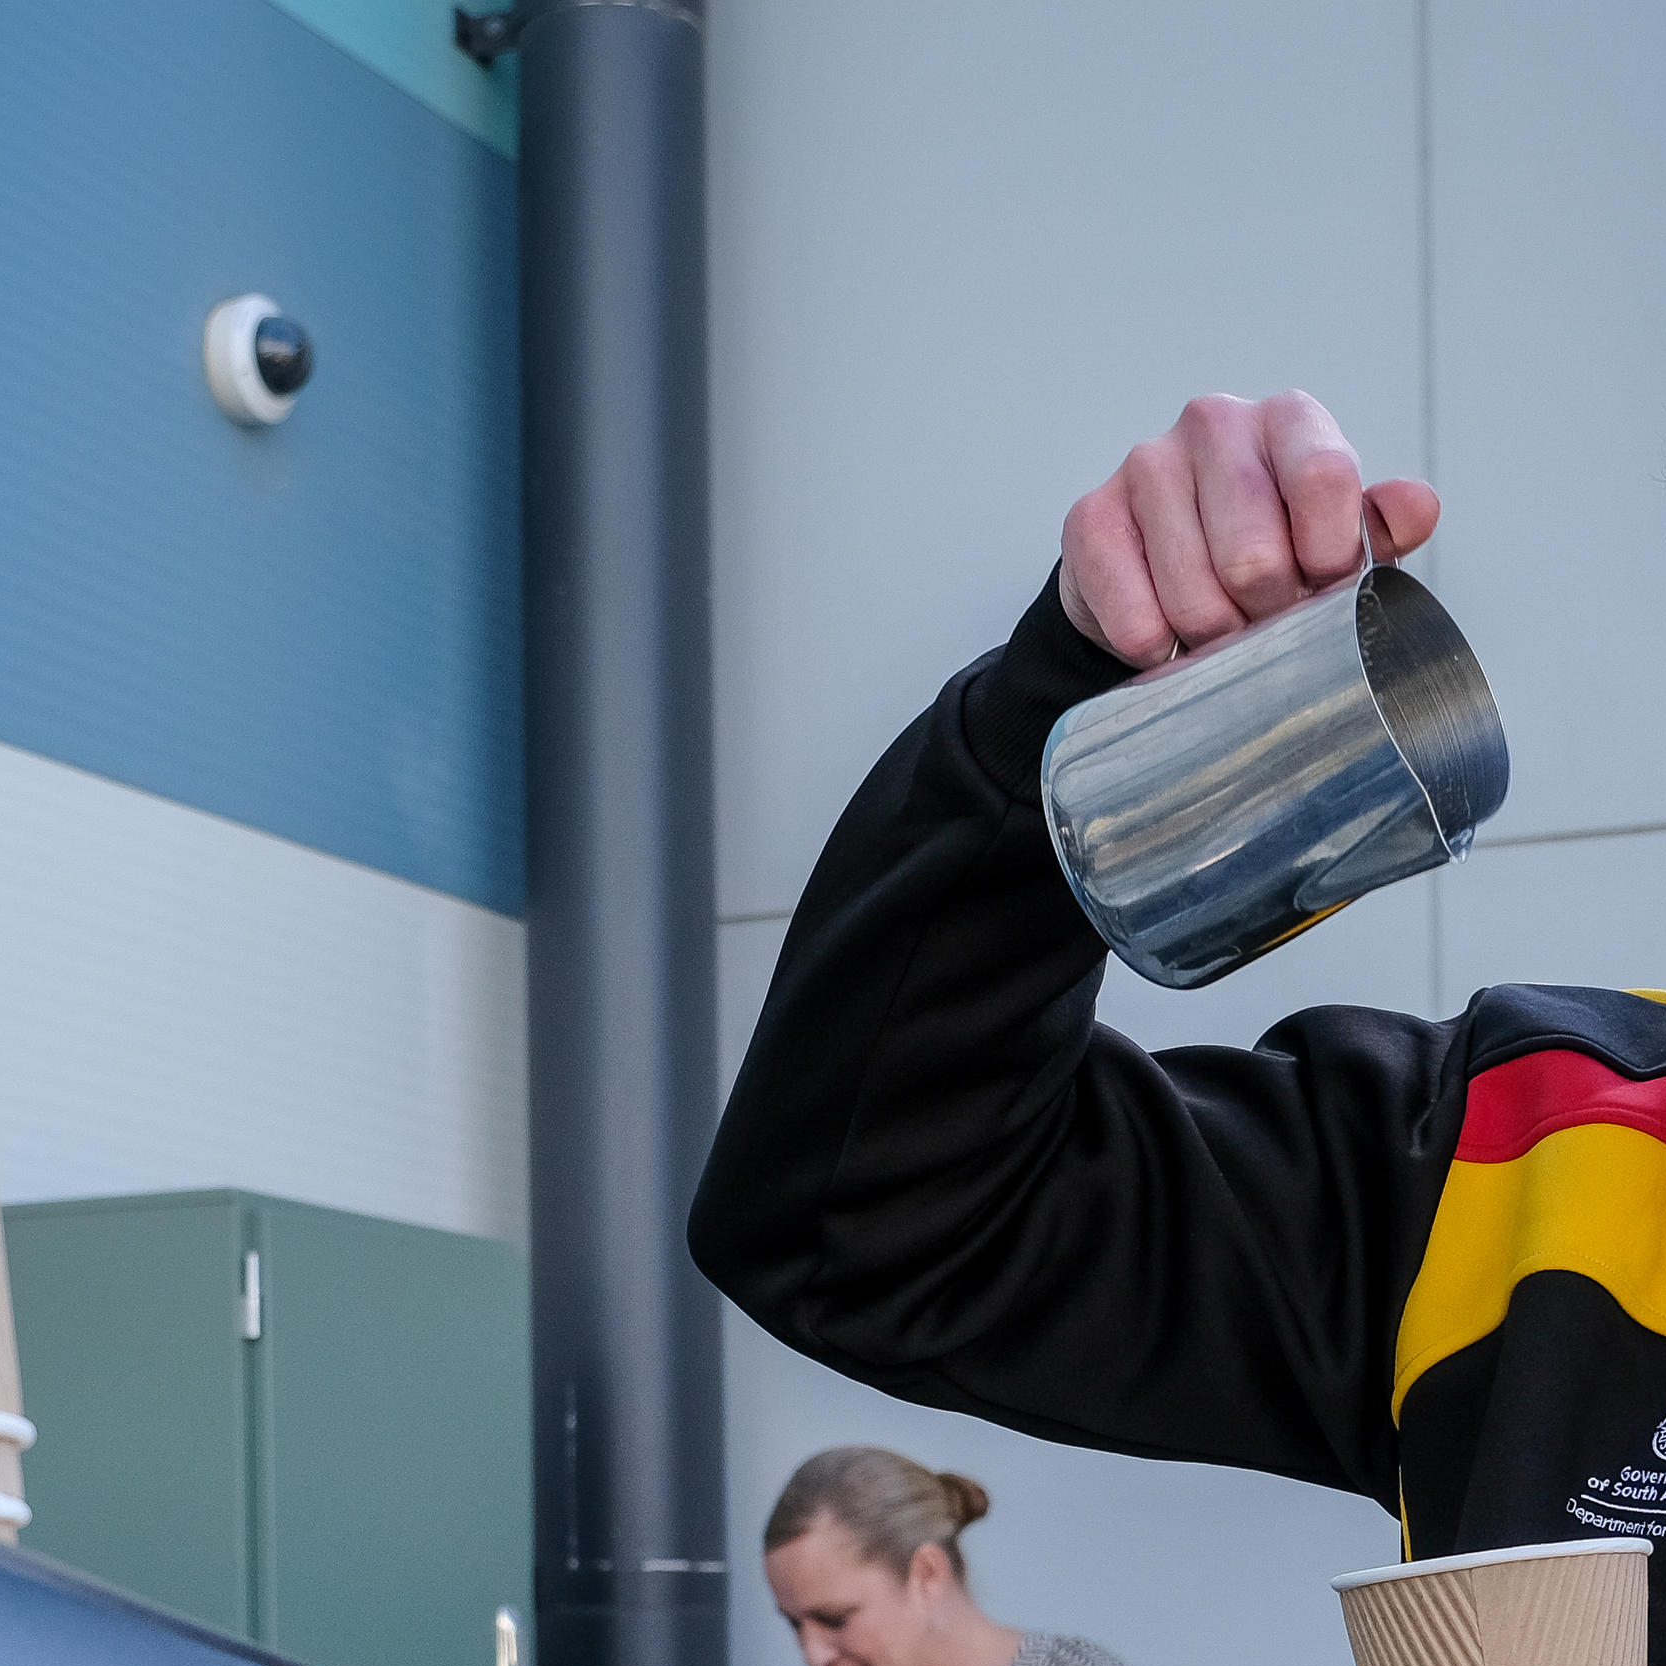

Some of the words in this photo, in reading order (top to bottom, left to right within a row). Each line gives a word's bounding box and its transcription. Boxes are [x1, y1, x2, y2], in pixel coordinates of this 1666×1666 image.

[1587, 1477, 1610, 1492] of
[1611, 1482, 1658, 1502] South
[1565, 1497, 1645, 1536] Department
